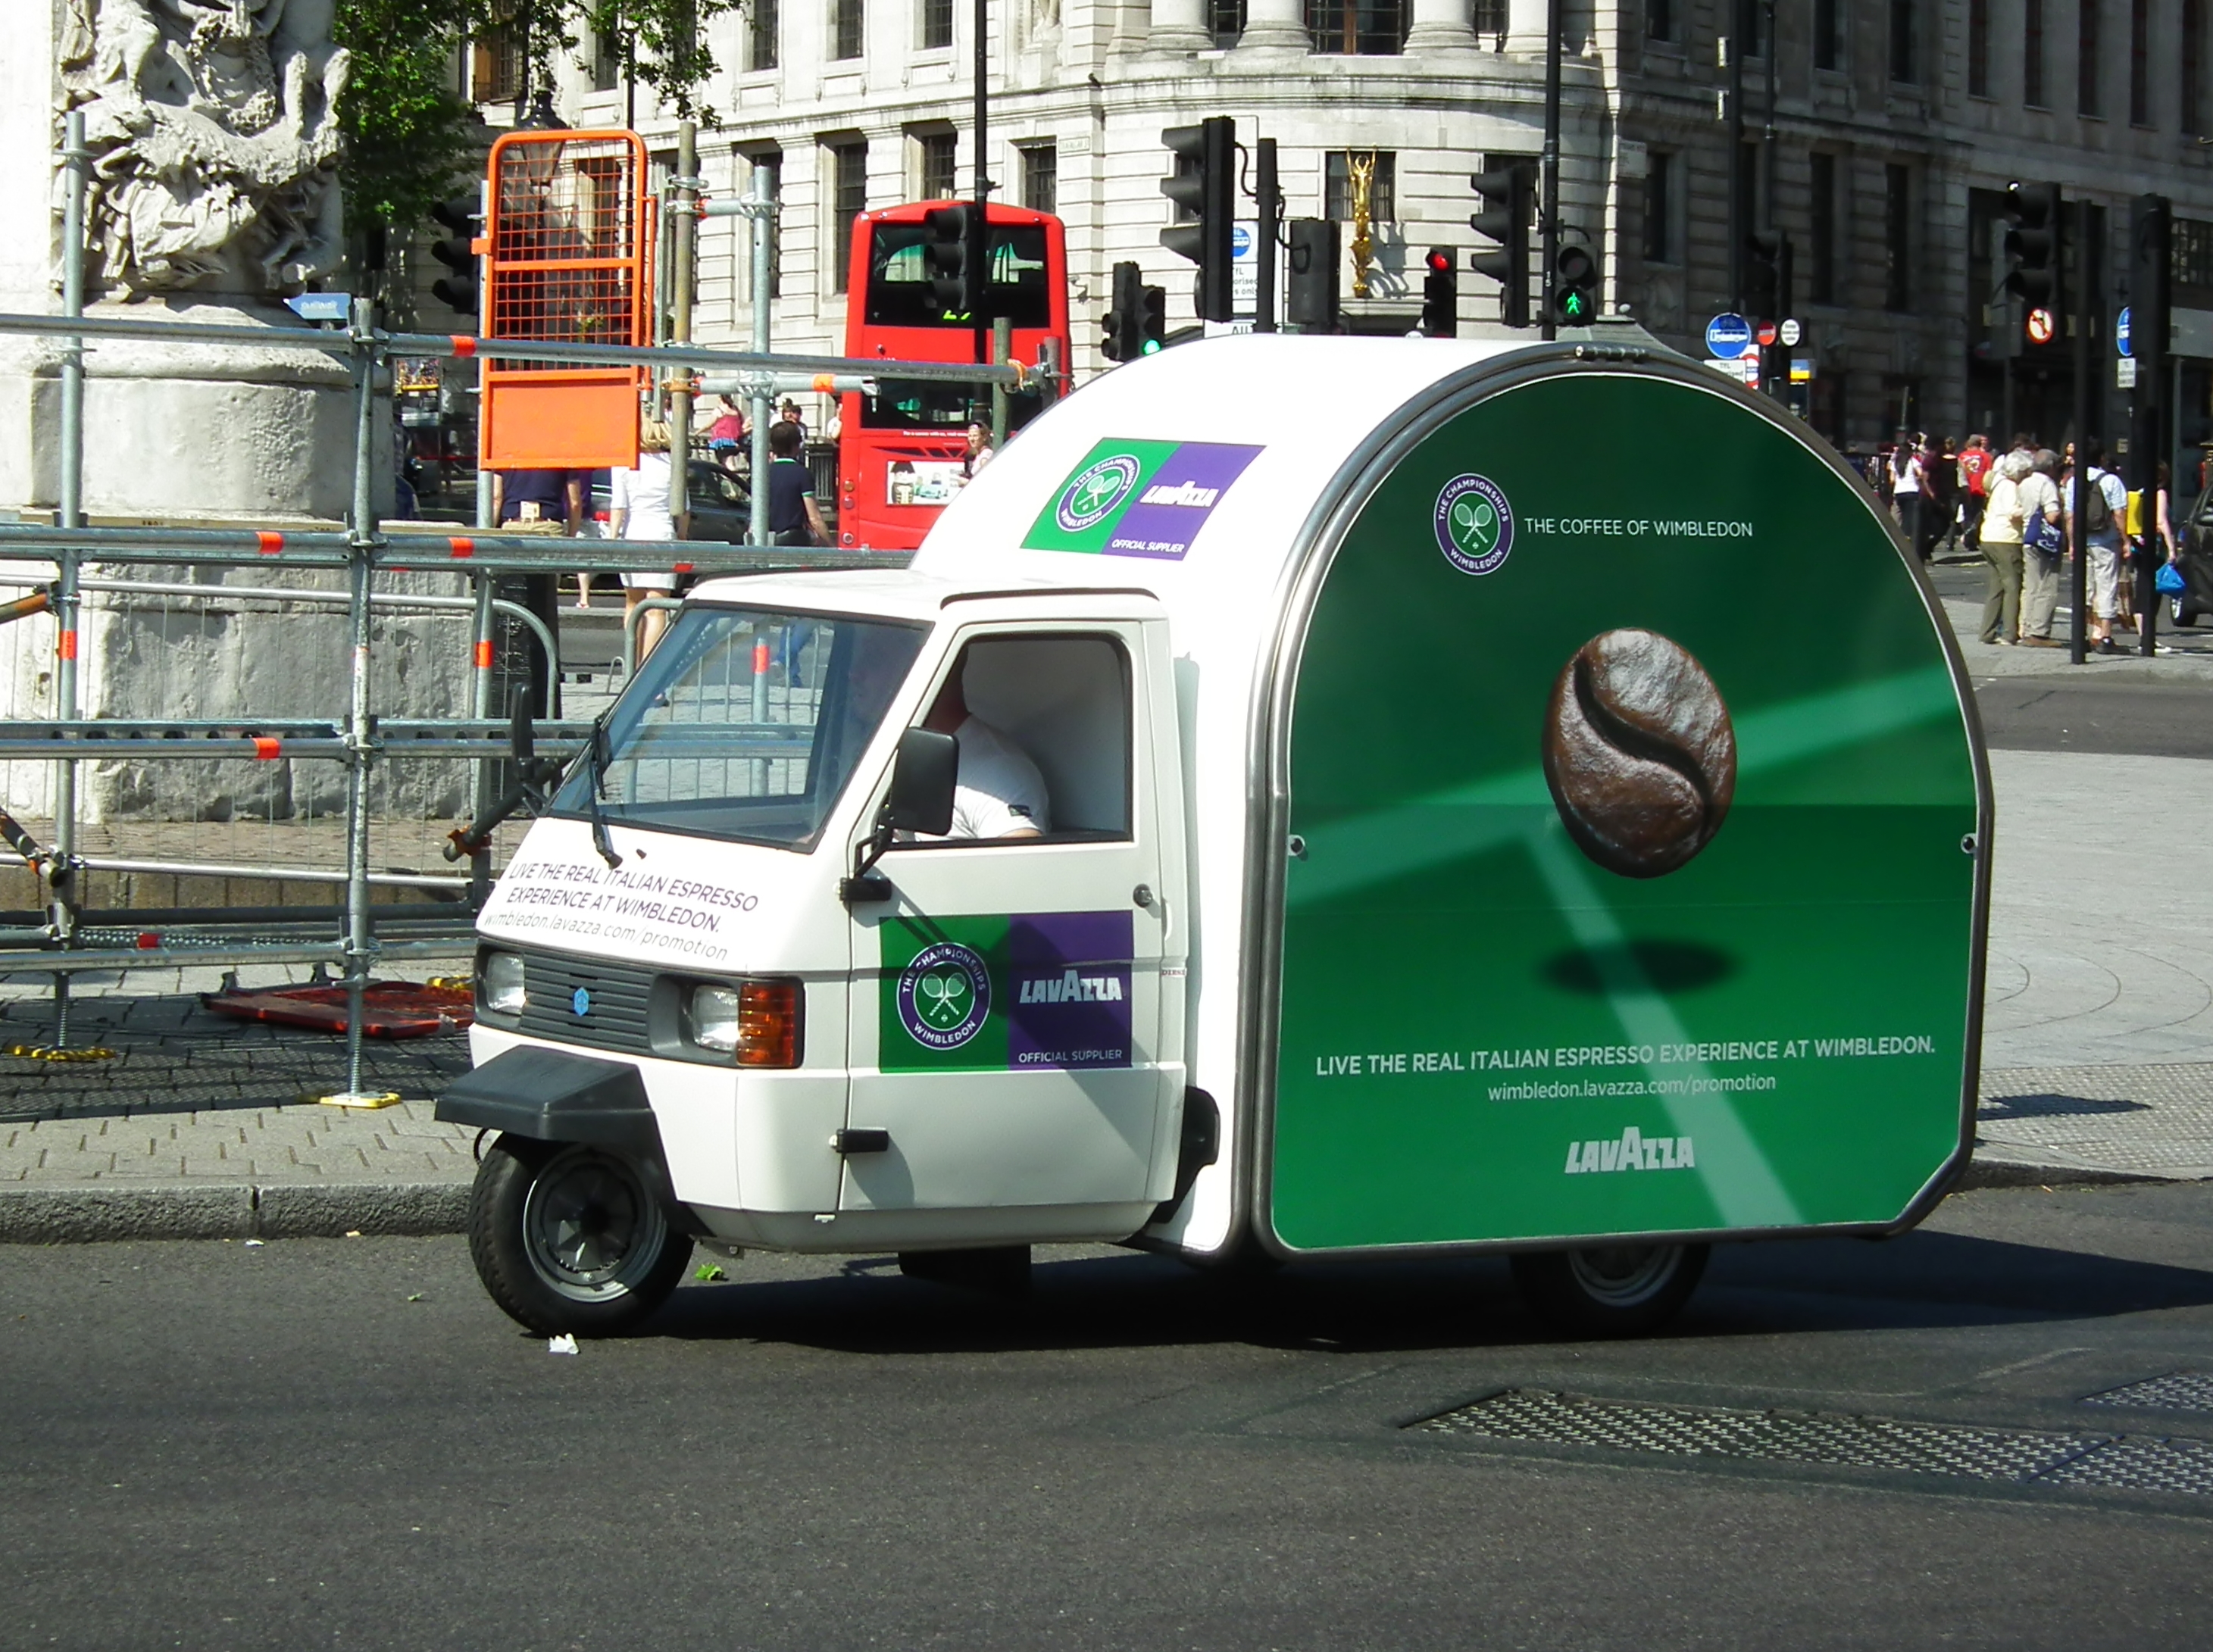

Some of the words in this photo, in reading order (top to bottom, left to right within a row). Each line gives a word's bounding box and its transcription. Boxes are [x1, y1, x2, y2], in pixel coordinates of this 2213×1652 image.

[1074, 470, 1092, 489] THE
[1093, 458, 1139, 492] CHAMPIONSHIPS
[1140, 480, 1219, 507] LAVAZZA
[1439, 498, 1449, 521] THE
[1446, 479, 1508, 523] CHAMPIONSHIPS
[1061, 507, 1102, 527] WIMBLEDON
[1524, 517, 1556, 534] THE
[1560, 519, 1623, 536] COFFEE
[1627, 520, 1649, 536] OF
[1653, 520, 1753, 537] WIMBLEDON
[1111, 539, 1146, 551] OFFICIAL
[1146, 541, 1185, 553] SUPPLIER
[1449, 548, 1503, 570] WIMBLEDON
[508, 863, 539, 880] LIVE
[537, 863, 566, 882] THE
[566, 866, 600, 885] REAL
[603, 869, 669, 894] ITALIAN
[667, 879, 759, 912] ESPRESSO
[506, 887, 591, 910] EXPERIENCE
[591, 894, 615, 910] AT
[615, 897, 722, 933] WIMBLEDON.
[483, 911, 728, 961] wimbledon.lavazza.com/promotion
[902, 970, 915, 993] THE
[915, 948, 986, 990] CHAMPIONSHIPS
[1019, 970, 1123, 1004] LAVAZZA
[914, 1020, 976, 1045] WIMBLEDON
[1018, 1051, 1068, 1063] OFFICIAL
[1071, 1050, 1122, 1061] SUPPLIER
[1316, 1055, 1361, 1076] LIVE
[1367, 1054, 1407, 1074] THE
[1412, 1052, 1465, 1072] REAL
[1471, 1048, 1549, 1070] ITALIAN
[1555, 1045, 1654, 1066] ESPRESSO
[1660, 1041, 1778, 1063] EXPERIENCE
[1783, 1039, 1809, 1058] AT
[1814, 1035, 1935, 1057] WIMBLEDON.
[1488, 1073, 1776, 1101] wimbledon.lavazza.com/promotion
[1564, 1126, 1696, 1173] LAVAZZA
